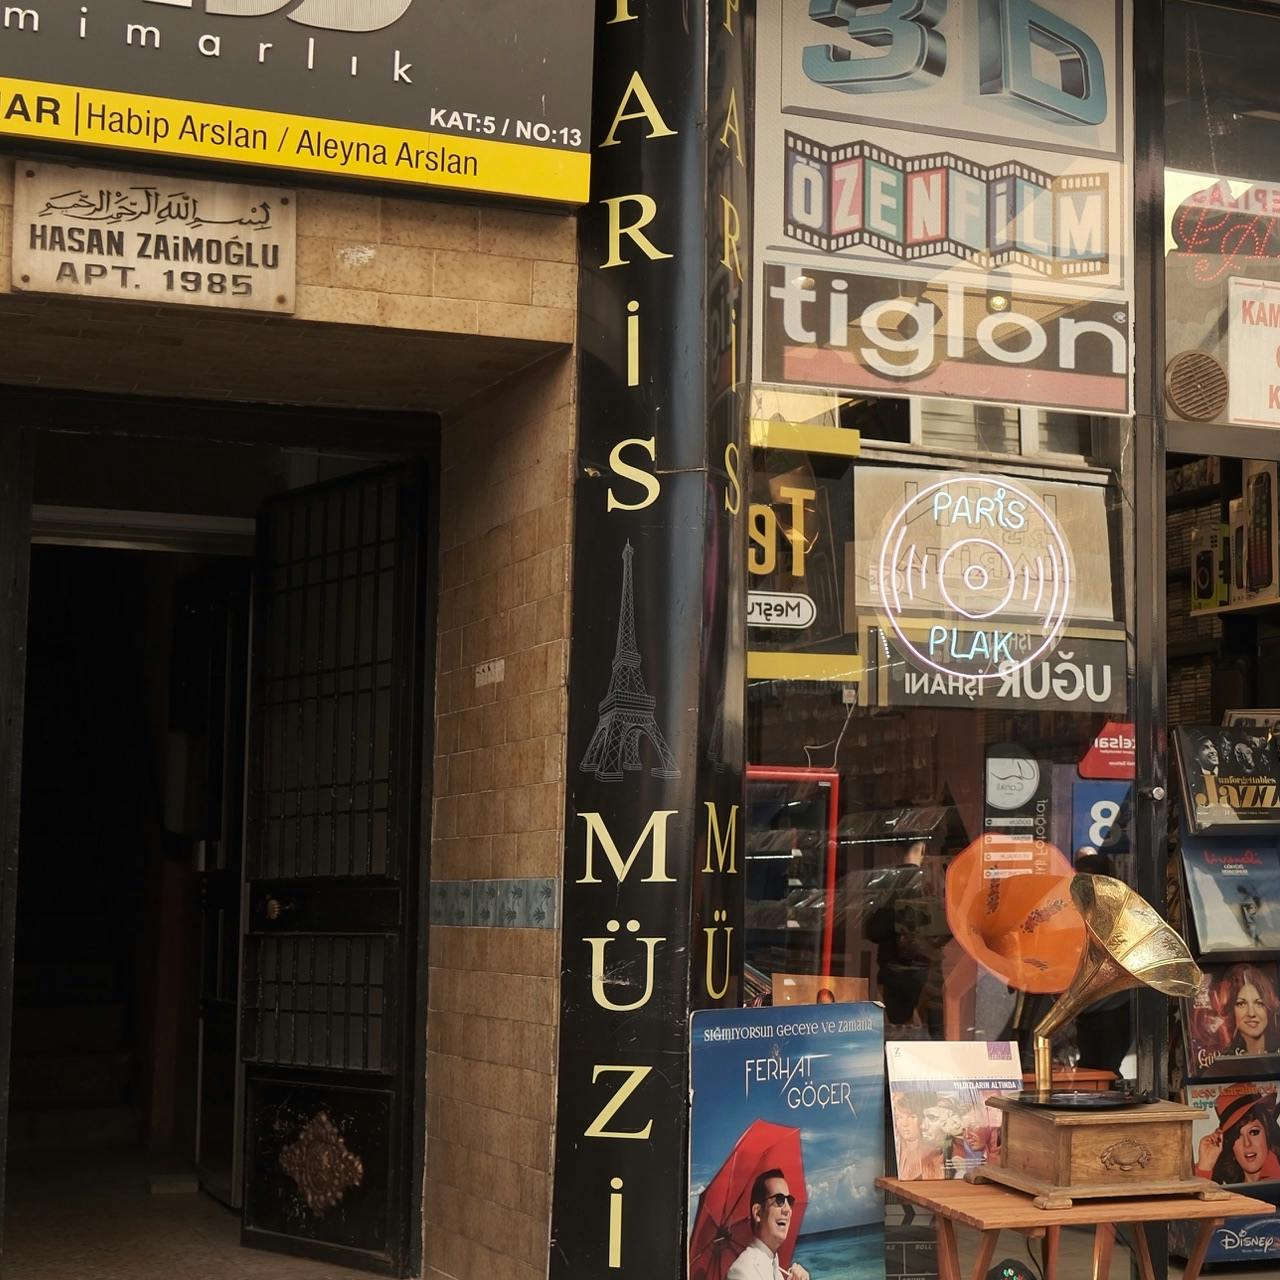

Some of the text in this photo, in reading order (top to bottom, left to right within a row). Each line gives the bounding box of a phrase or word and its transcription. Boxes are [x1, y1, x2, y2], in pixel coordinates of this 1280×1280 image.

[3, 4, 414, 85] mimarlık
[0, 94, 62, 126] AR
[87, 103, 169, 142] Habip
[178, 115, 268, 151] Arslan
[295, 128, 388, 167] Aleyna
[394, 142, 480, 177] Arslan
[430, 107, 497, 137] KAT:5
[516, 121, 583, 148] NO:13
[29, 223, 125, 257] HASAN
[56, 261, 252, 297] APT. 1985
[929, 625, 1015, 664] PLAK
[745, 1053, 833, 1104] FERHAT
[787, 1081, 858, 1119] GÖÇER
